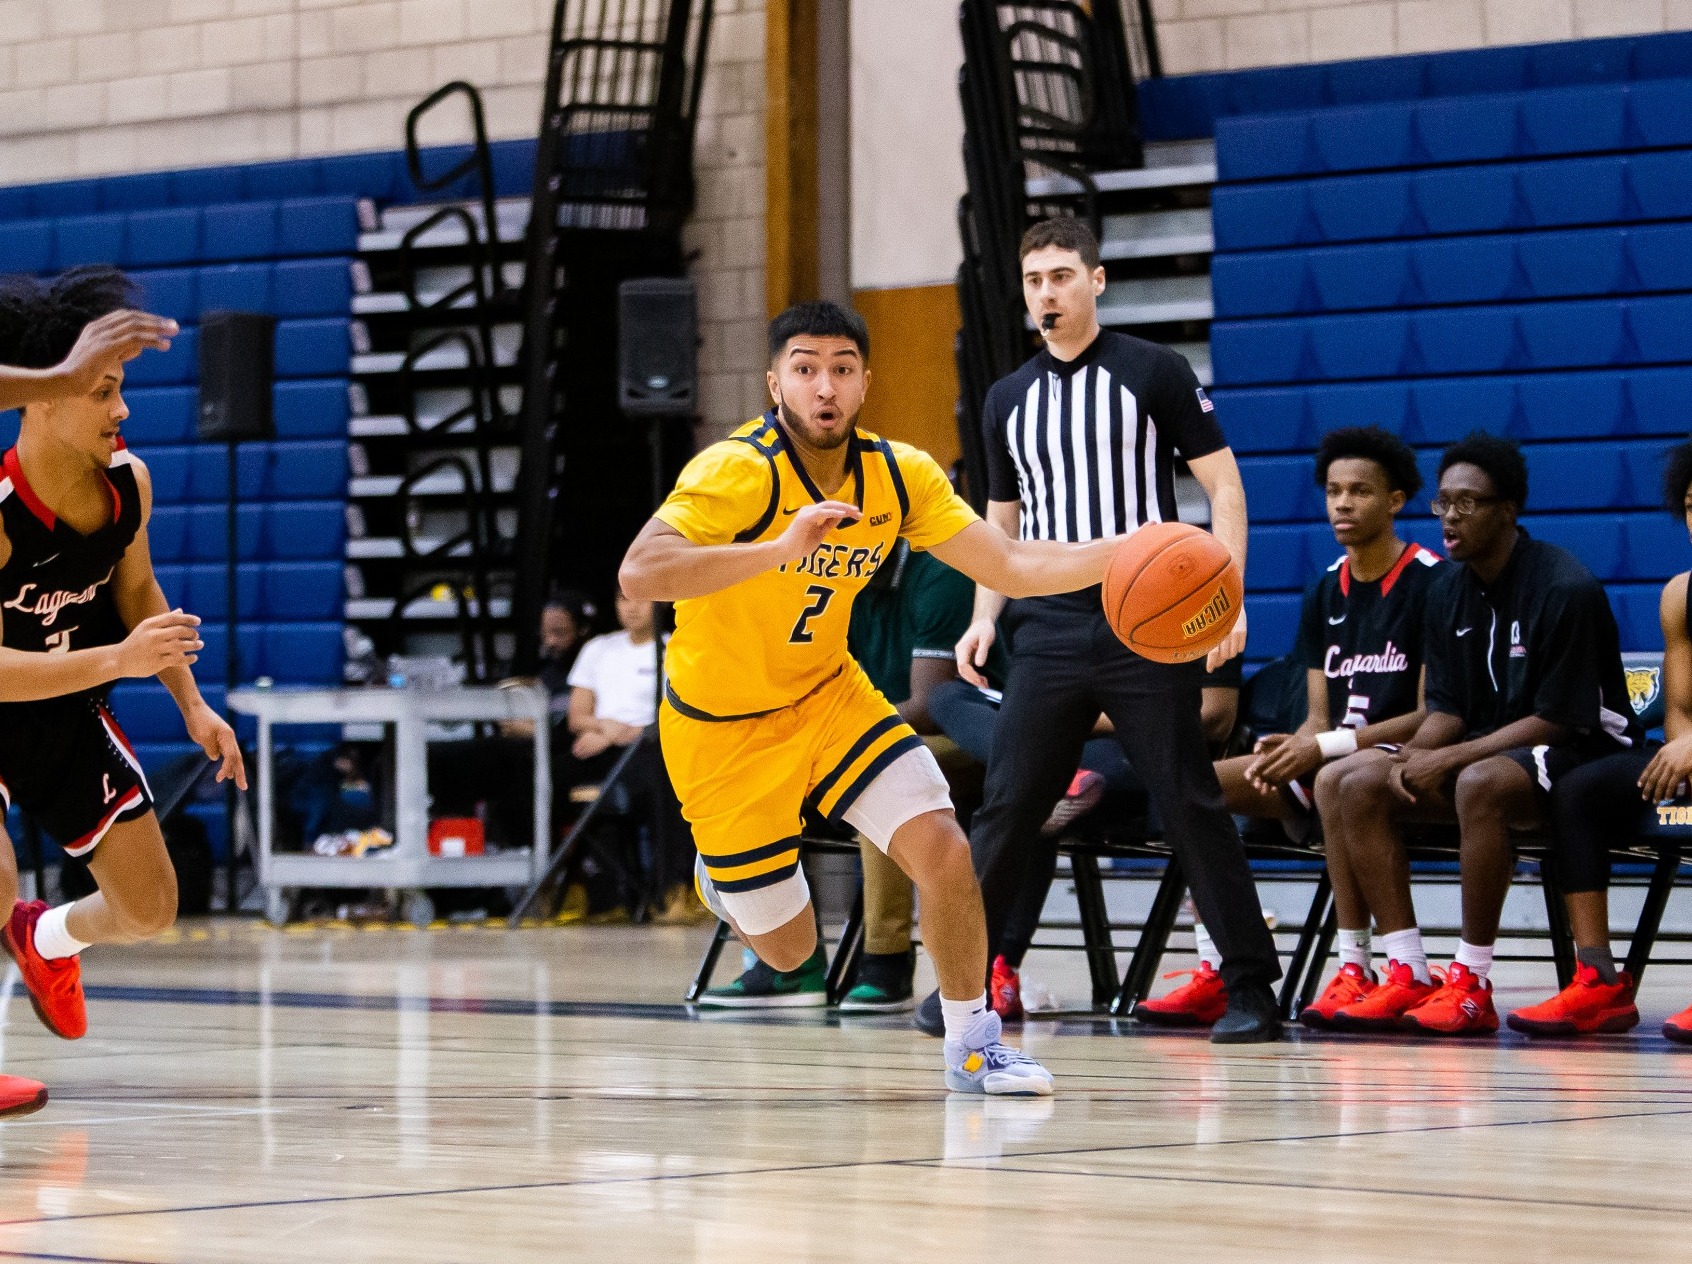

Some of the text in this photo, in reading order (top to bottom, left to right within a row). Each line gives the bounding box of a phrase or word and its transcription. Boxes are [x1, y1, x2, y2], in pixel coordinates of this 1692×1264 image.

[788, 584, 836, 644] 2
[1182, 584, 1232, 638] NJCAA
[1341, 694, 1371, 732] 5
